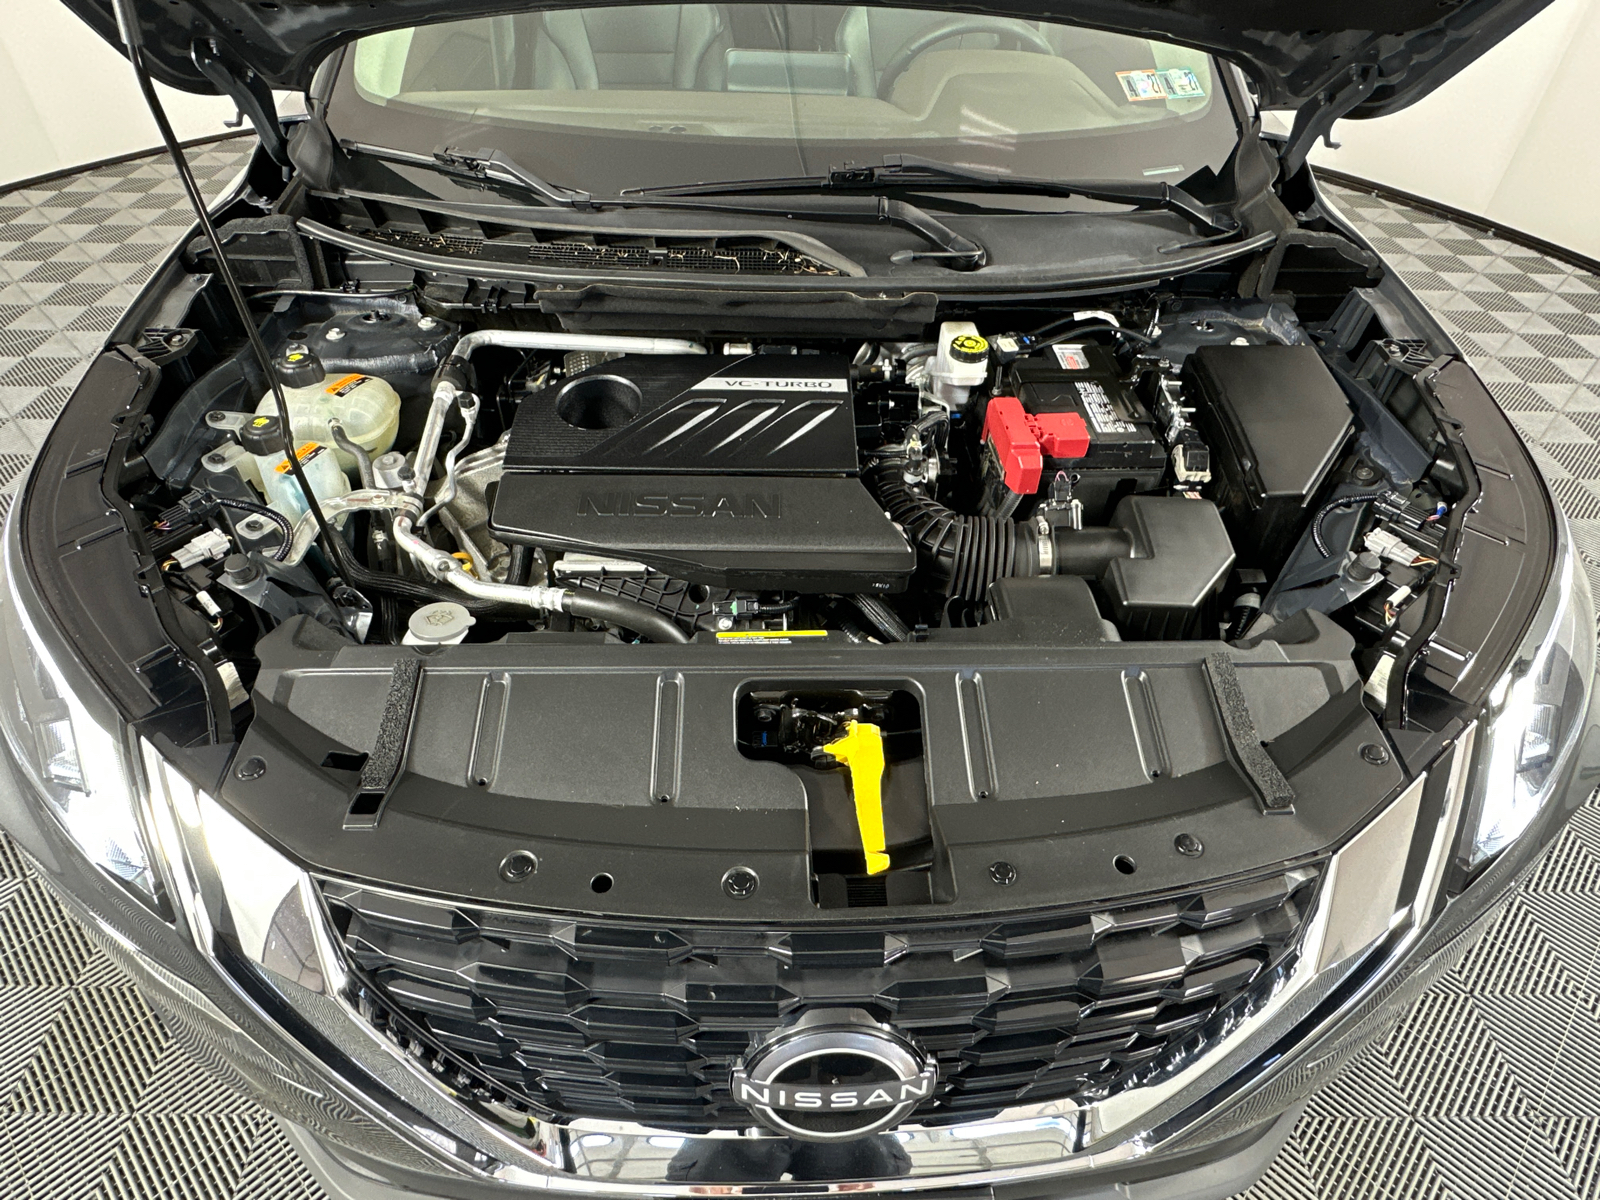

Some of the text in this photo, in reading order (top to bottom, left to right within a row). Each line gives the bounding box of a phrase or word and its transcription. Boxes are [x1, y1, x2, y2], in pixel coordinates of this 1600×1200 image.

[724, 380, 832, 389] VC-TURBO
[577, 492, 782, 519] NISSAN
[740, 1079, 928, 1108] NISSAN
